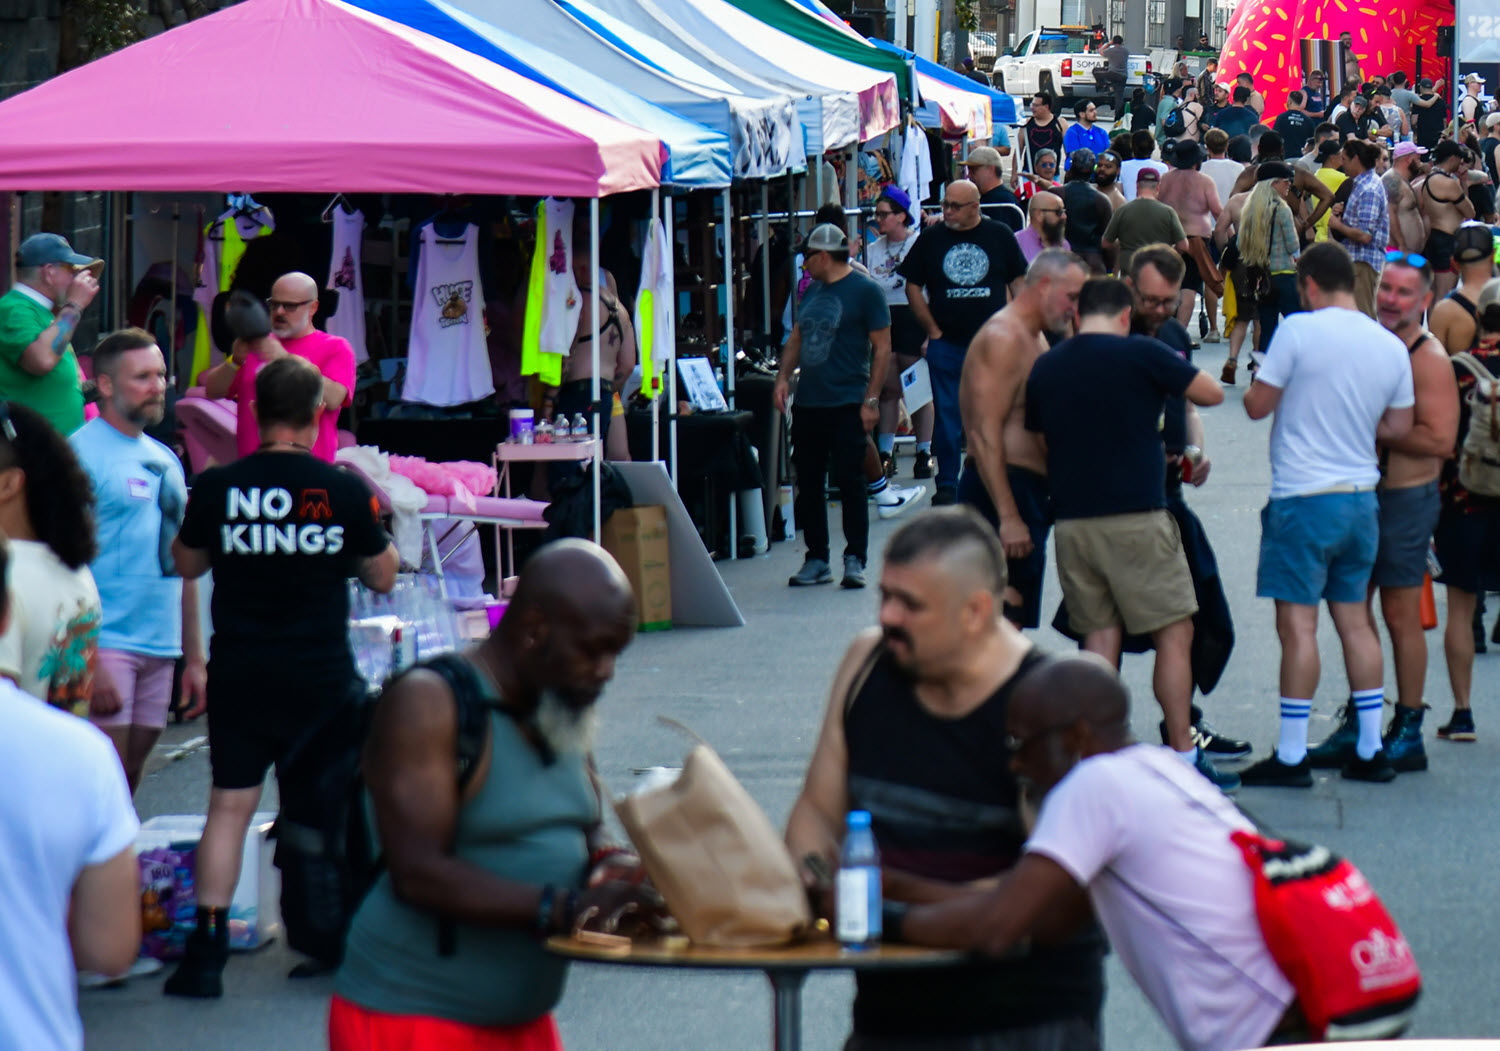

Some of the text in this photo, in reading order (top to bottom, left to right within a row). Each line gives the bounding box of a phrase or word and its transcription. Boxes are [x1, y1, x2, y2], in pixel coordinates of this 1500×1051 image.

[1076, 61, 1101, 69] SOMA
[226, 486, 293, 521] NO
[221, 522, 345, 556] KINGS
